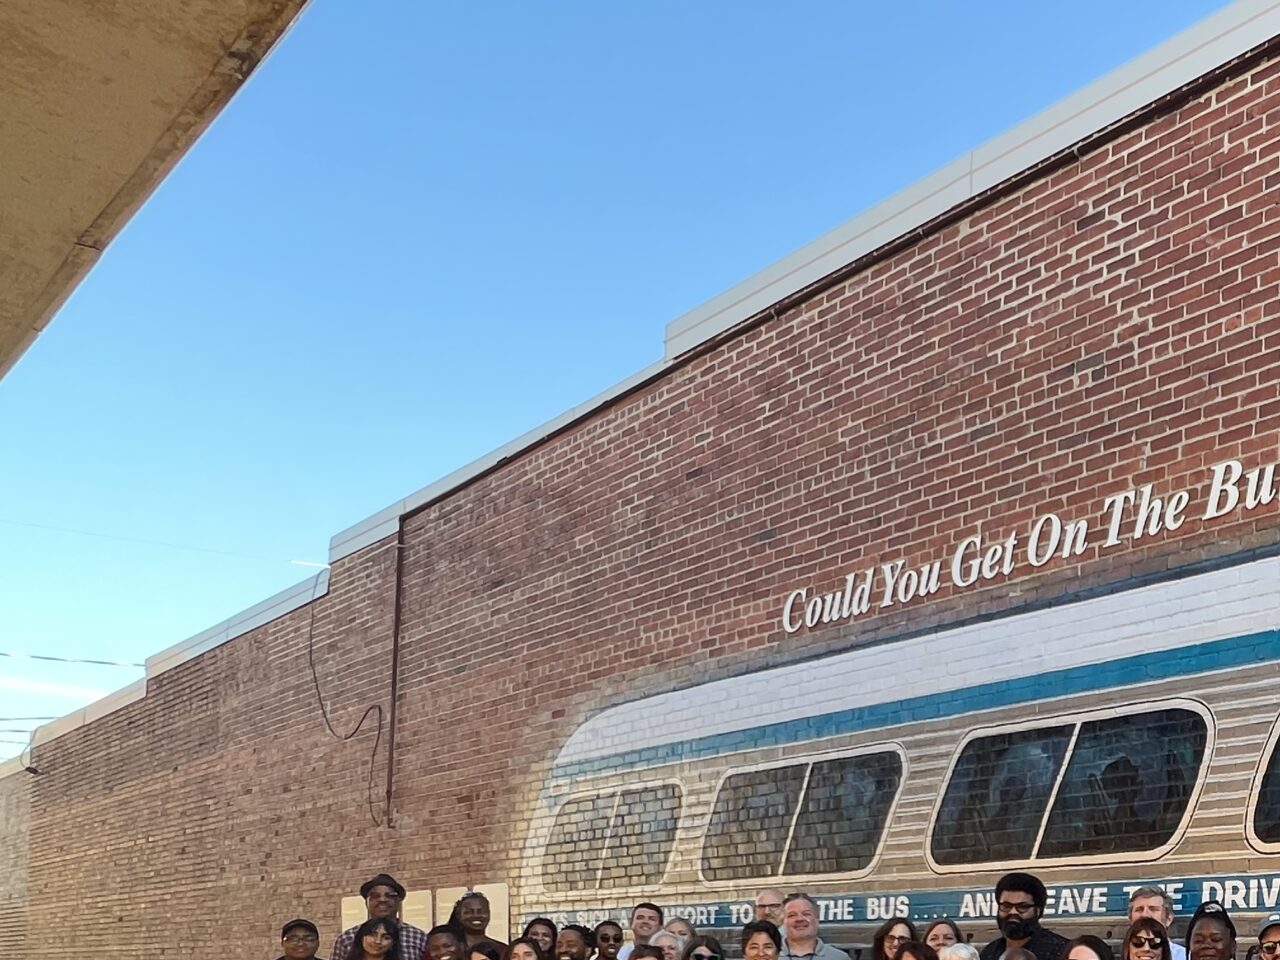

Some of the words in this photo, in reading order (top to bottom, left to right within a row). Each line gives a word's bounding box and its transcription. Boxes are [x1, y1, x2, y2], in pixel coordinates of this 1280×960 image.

[782, 566, 872, 633] Could
[879, 560, 941, 608] You
[951, 534, 1019, 588] Get
[1028, 513, 1088, 568] On
[1101, 482, 1188, 549] The
[729, 903, 754, 924] TO
[817, 899, 854, 921] THE
[1045, 887, 1108, 915] EAVE
